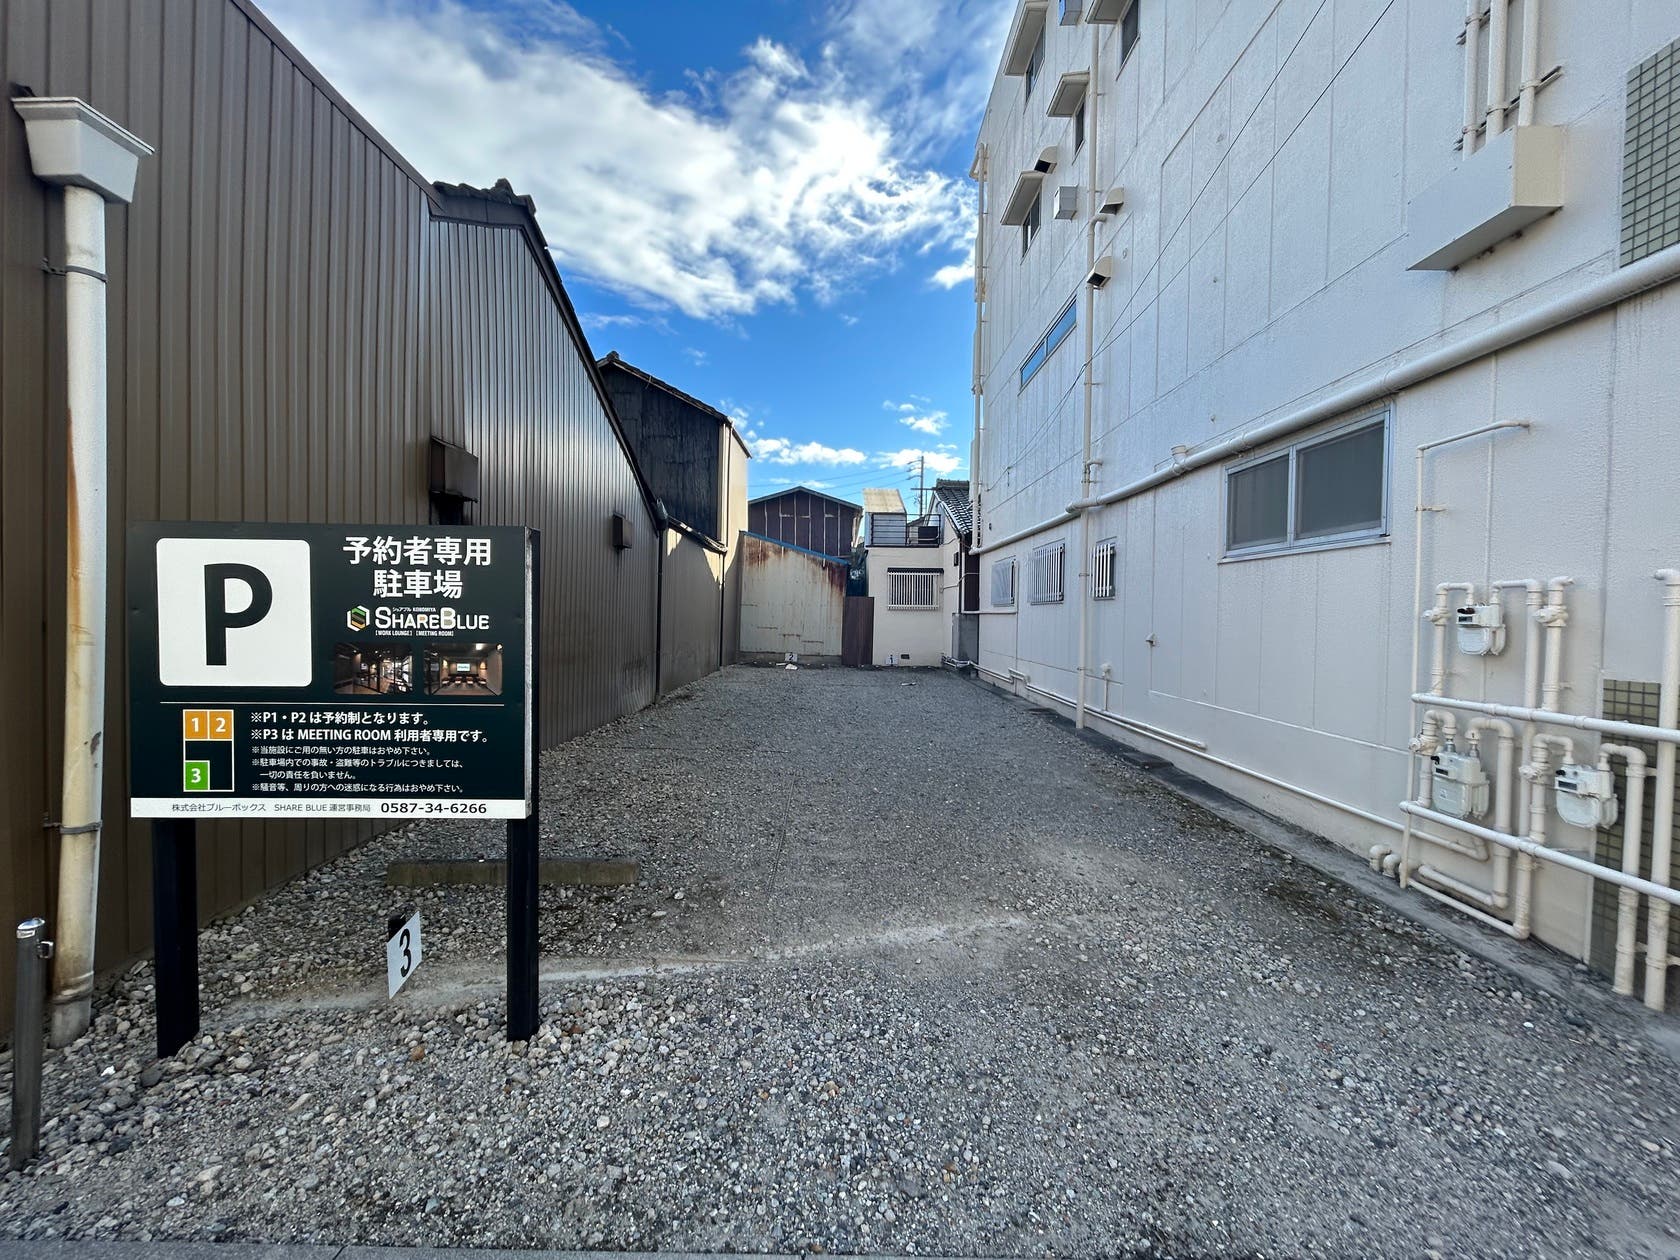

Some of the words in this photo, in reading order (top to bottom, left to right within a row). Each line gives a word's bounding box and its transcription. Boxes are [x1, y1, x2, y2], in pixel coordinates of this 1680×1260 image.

[343, 536, 492, 566] 予約者専用
[373, 569, 463, 599] 駐車場
[204, 562, 273, 667] P
[191, 717, 200, 732] 1
[215, 717, 226, 732] 2
[297, 729, 352, 741] MEETING
[354, 729, 391, 741] ROOM
[394, 728, 488, 743] 利用者専用です。
[191, 767, 201, 783] 3
[259, 770, 356, 780] 一切の責任を負いません。
[172, 803, 266, 812] 株式会社ブルーボックス
[274, 804, 303, 812] SHARE
[305, 804, 328, 812] BLUE
[329, 804, 371, 812] 運営事務局
[381, 802, 487, 814] 0587-34-6266
[399, 928, 412, 978] 3
